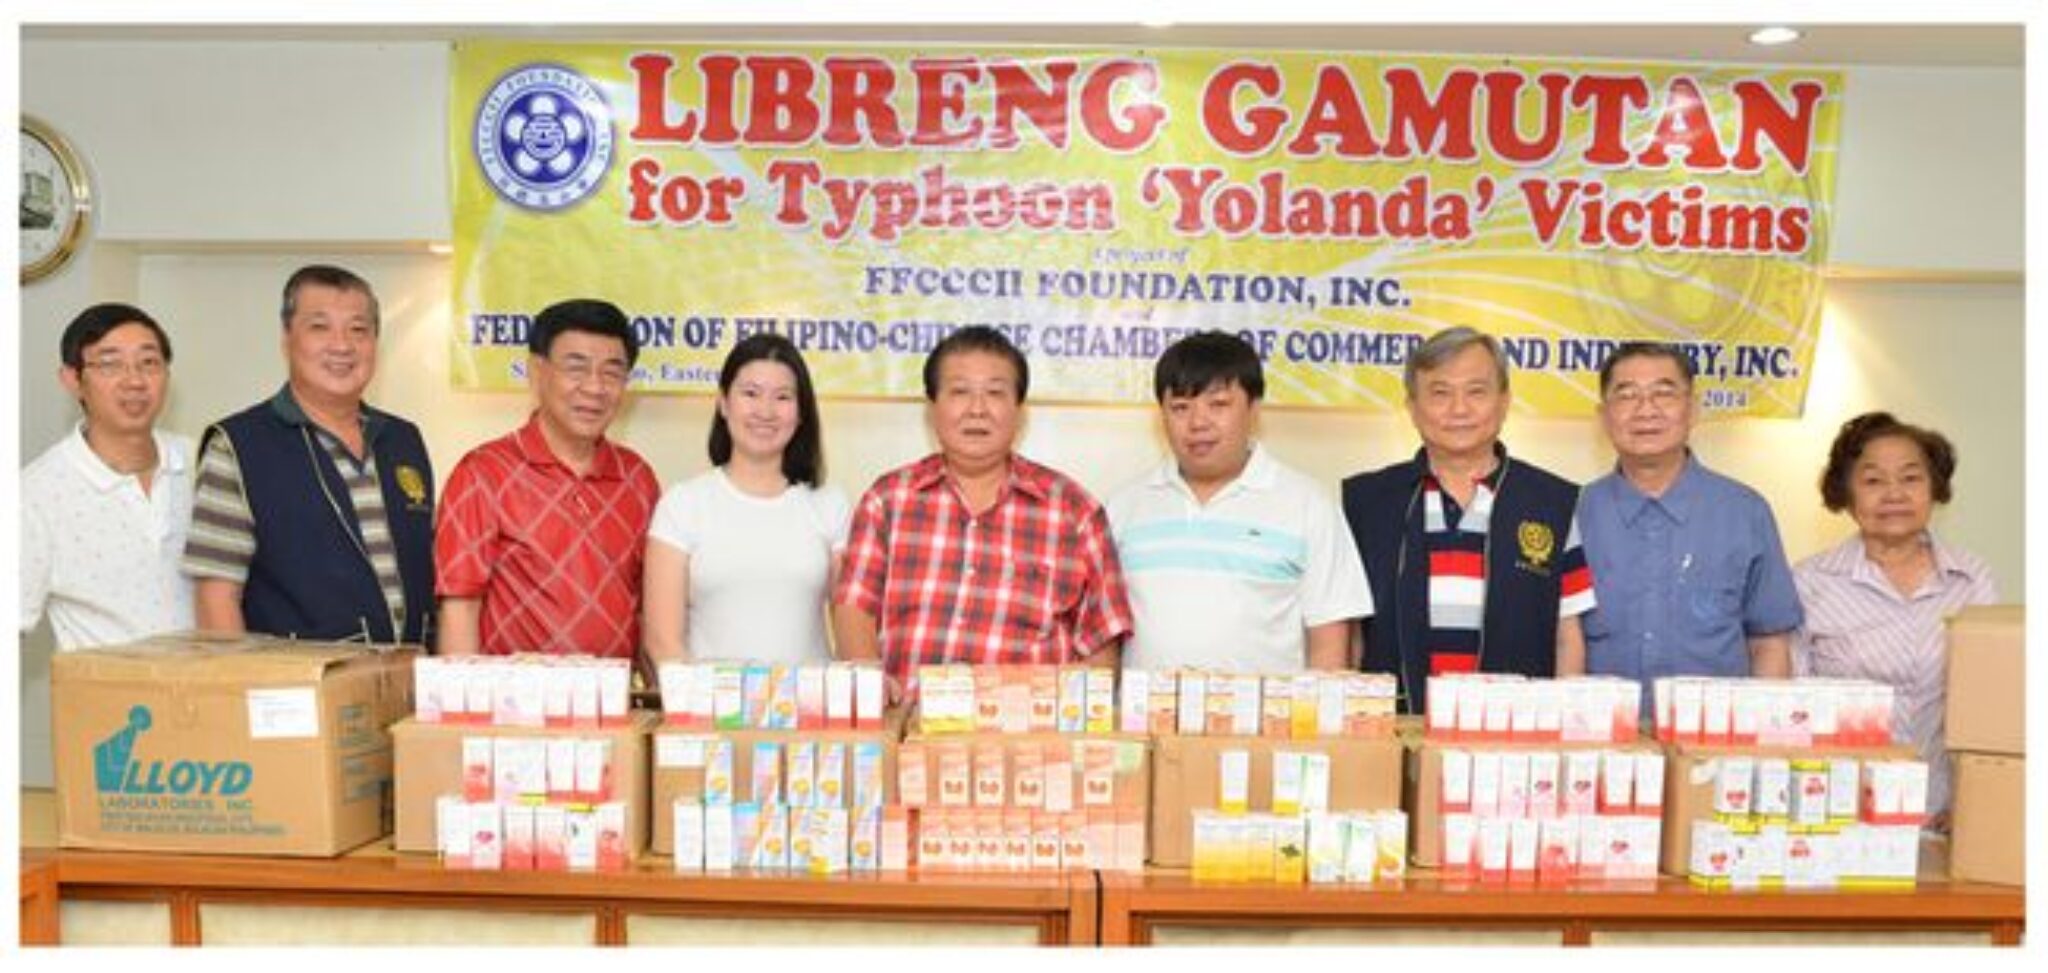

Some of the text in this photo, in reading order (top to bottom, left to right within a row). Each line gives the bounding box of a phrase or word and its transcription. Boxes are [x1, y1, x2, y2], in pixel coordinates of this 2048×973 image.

[628, 53, 1824, 173] LIBRENG GAMUTAN
[628, 157, 745, 223] for
[767, 160, 1116, 240] Typhoon
[1521, 179, 1810, 253] Victims
[864, 265, 1412, 309] FFCCCII FOUNDATION, INC.
[683, 316, 726, 349] OF
[1502, 335, 1549, 369] ND
[1734, 344, 1799, 379] INC.
[1702, 389, 1748, 408] 2014
[125, 760, 253, 796] LLOYD
